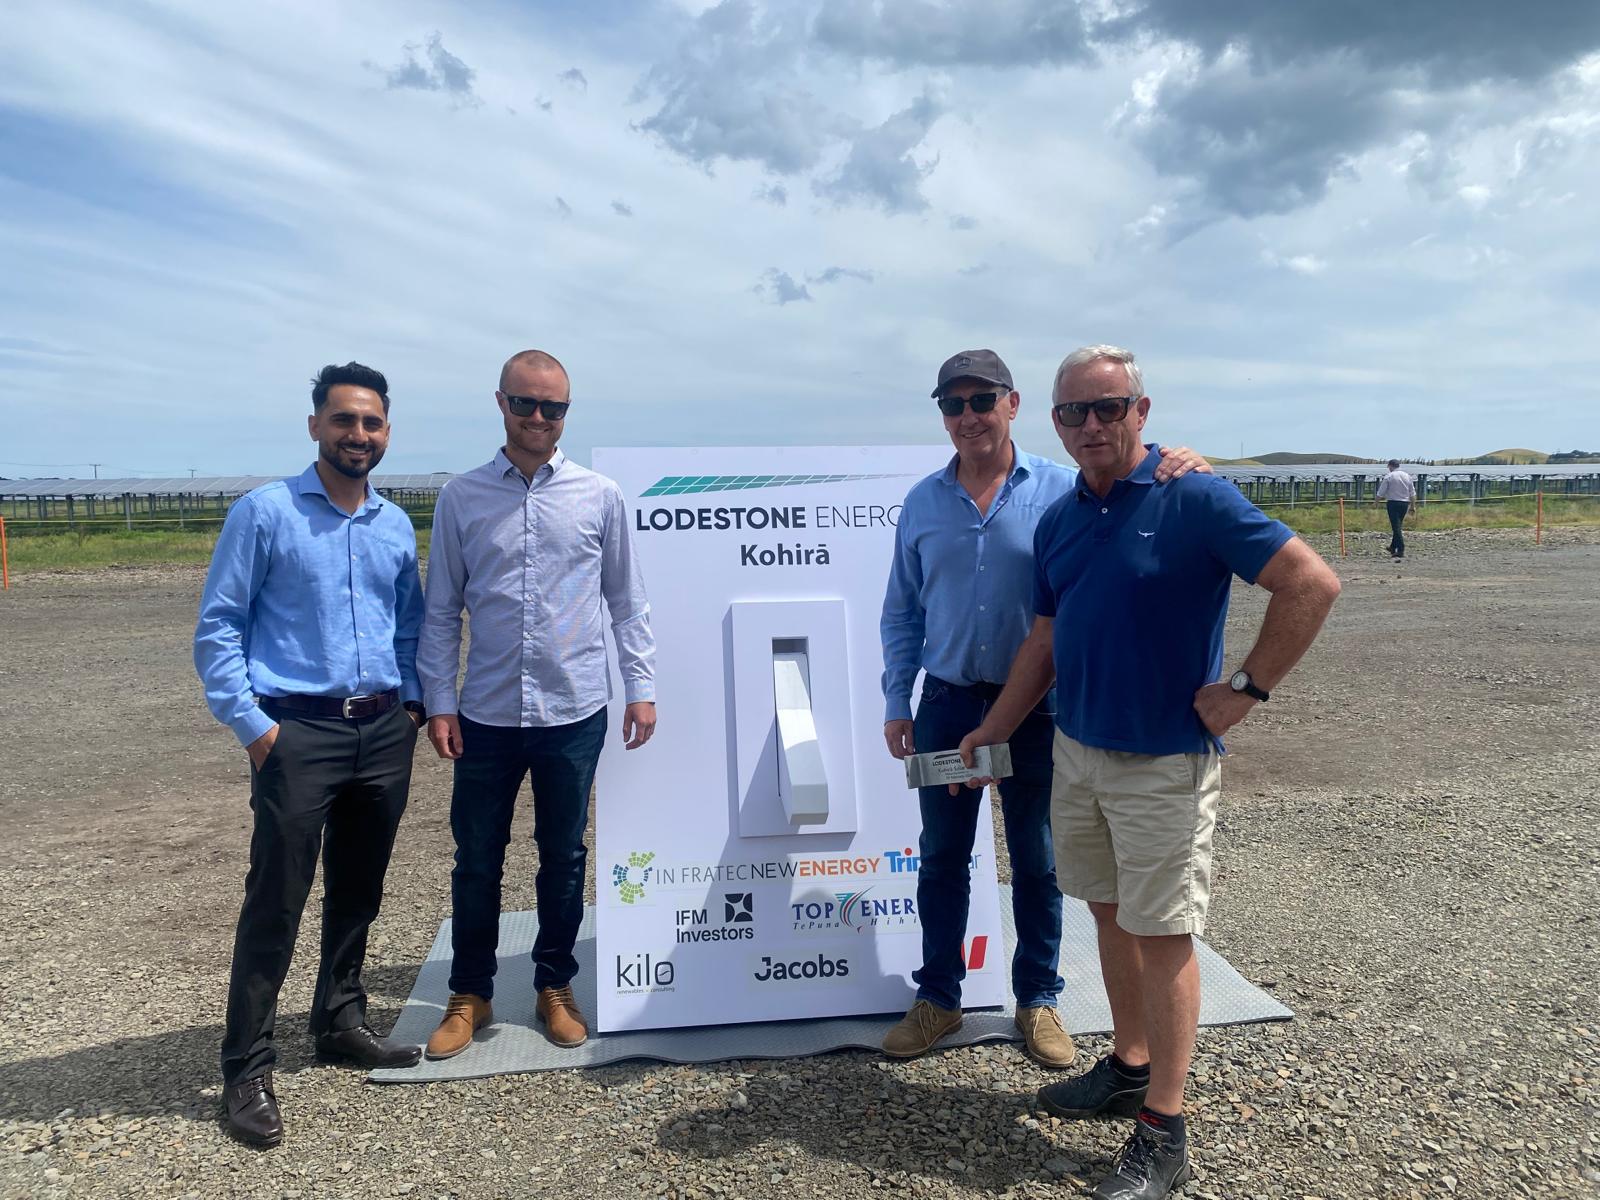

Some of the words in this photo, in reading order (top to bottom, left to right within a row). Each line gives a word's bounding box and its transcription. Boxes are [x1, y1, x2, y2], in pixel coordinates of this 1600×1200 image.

[636, 507, 807, 531] LODESTONE
[816, 505, 904, 528] ENER
[740, 543, 830, 566] Kohirā
[676, 908, 708, 926] IFM
[792, 902, 834, 921] TOP
[861, 898, 917, 917] ENER
[870, 916, 918, 926] Hihi
[676, 926, 754, 943] Investors
[616, 953, 675, 987] kilo
[754, 953, 849, 981] Jacobs
